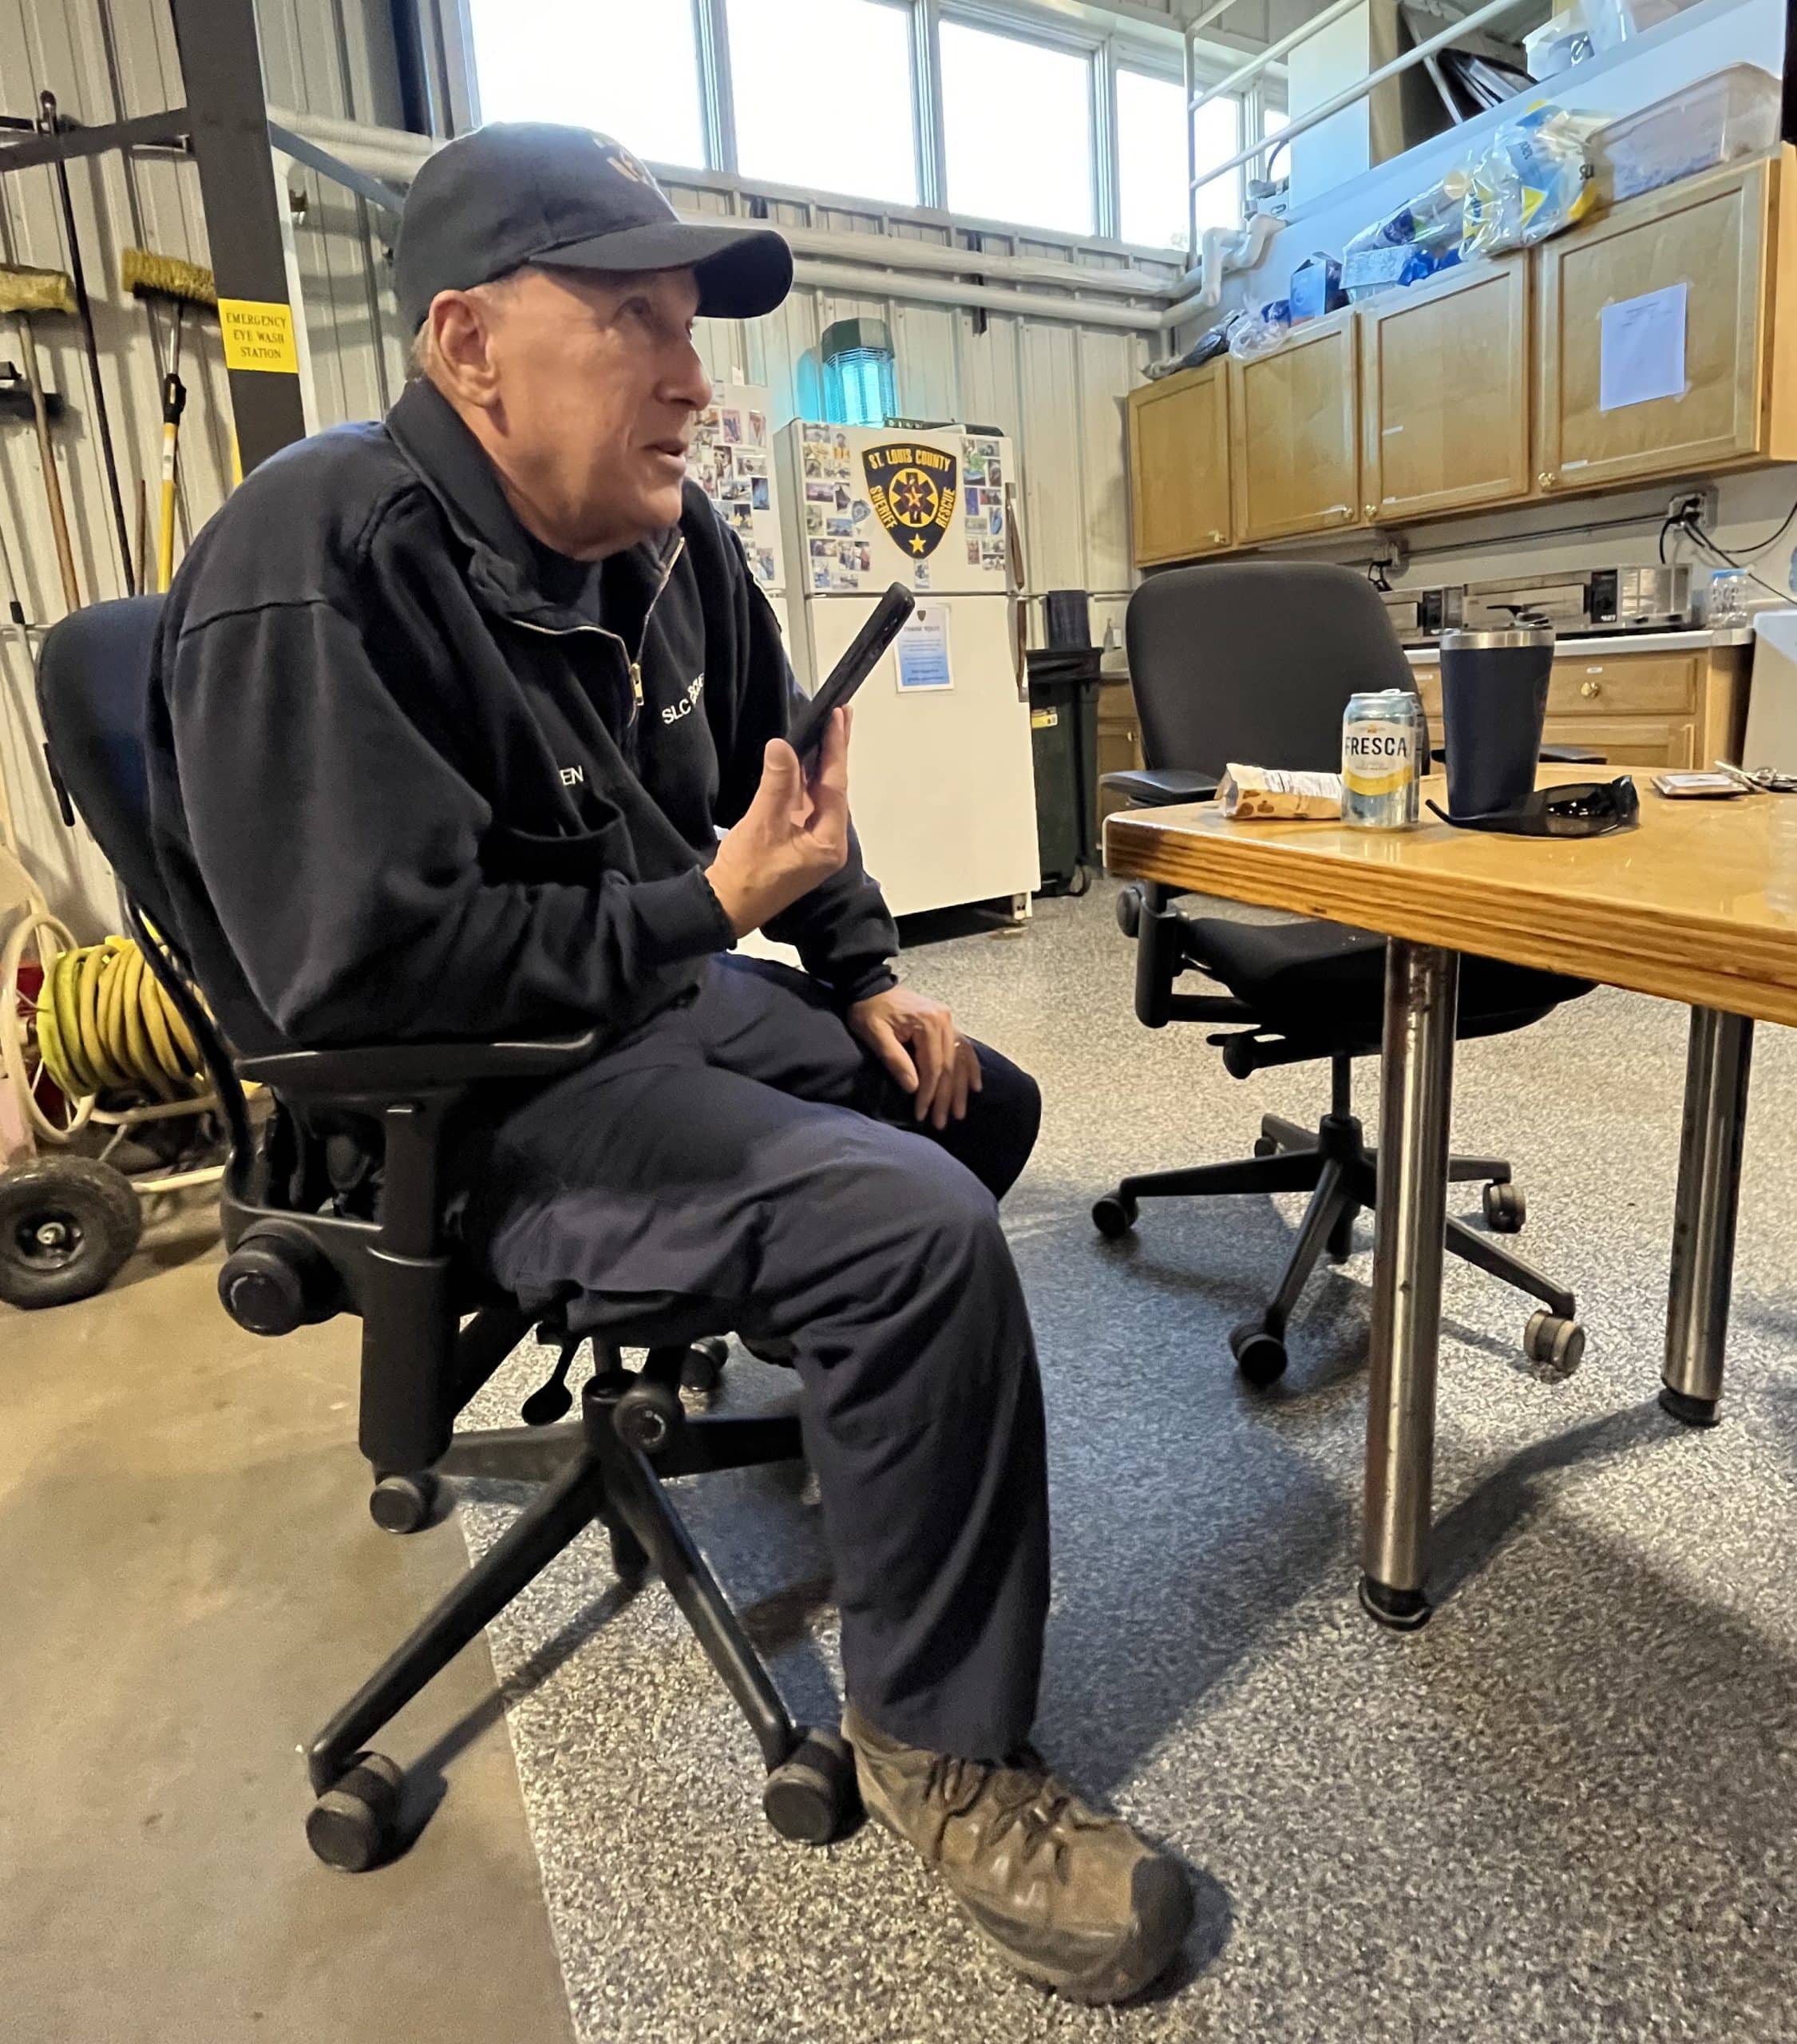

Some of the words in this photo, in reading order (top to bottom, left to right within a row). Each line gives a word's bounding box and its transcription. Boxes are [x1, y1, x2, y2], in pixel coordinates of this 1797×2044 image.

[225, 312, 287, 328] EMERGENCY
[233, 329, 253, 342] EYE
[256, 331, 285, 345] WASH
[240, 347, 282, 358] STATION
[868, 451, 885, 469] ST.
[885, 448, 913, 465] LOUIS
[915, 450, 952, 473] COUNTY
[869, 485, 899, 529] SHERIFF
[934, 486, 956, 529] RESCUE
[662, 698, 691, 724] SLC
[1344, 736, 1407, 758] FRESCA
